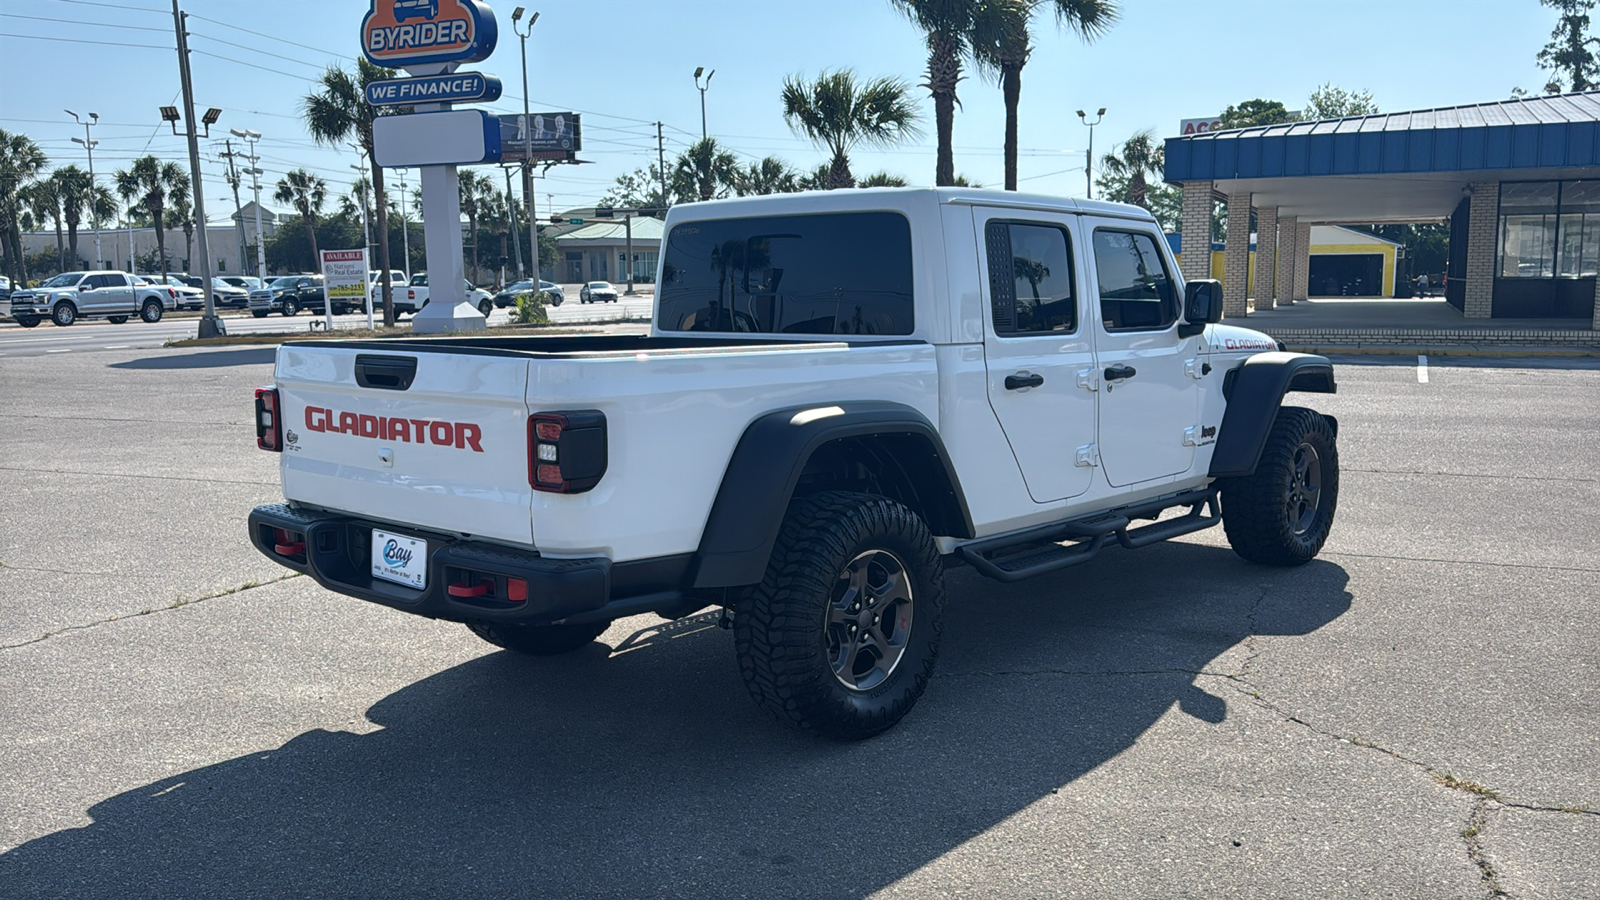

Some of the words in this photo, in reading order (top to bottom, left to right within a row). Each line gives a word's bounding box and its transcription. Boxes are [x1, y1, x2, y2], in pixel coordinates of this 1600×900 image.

[370, 20, 469, 51] BYRIDER
[371, 85, 397, 99] WE
[400, 79, 478, 97] FINANCE!
[326, 252, 362, 260] AVAILABLE
[305, 405, 485, 452] GLADIATOR
[385, 538, 413, 568] Bay
